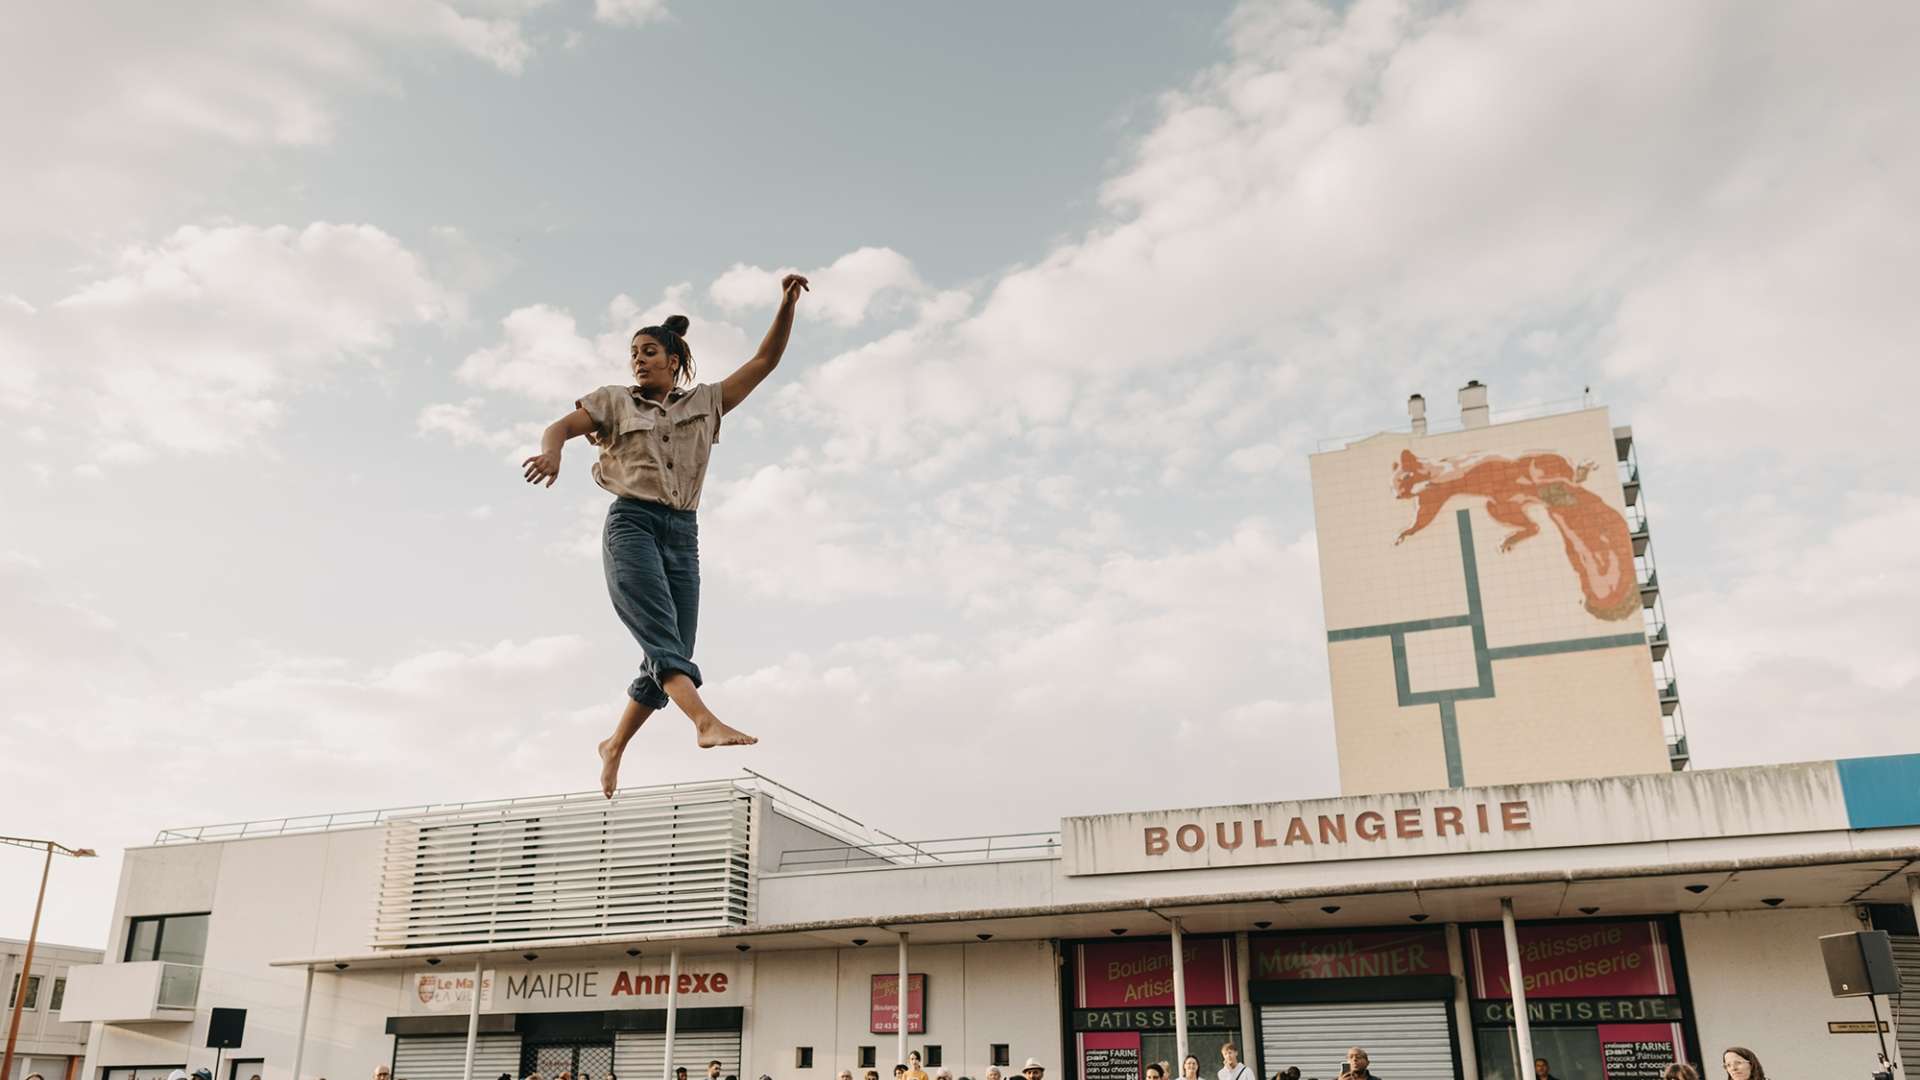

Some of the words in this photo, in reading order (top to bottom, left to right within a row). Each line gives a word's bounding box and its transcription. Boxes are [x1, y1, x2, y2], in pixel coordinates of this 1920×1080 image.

[1144, 800, 1532, 856] BOULANGERIE
[1499, 952, 1641, 994] Vennoiserie
[437, 979, 453, 990] Le
[456, 977, 490, 990] Mas
[506, 971, 599, 999] MAIRIE
[611, 970, 729, 996] Annexe
[1087, 1009, 1225, 1028] PATISSERIE
[1110, 1049, 1137, 1057] FARINE
[1605, 1048, 1633, 1056] pain
[1635, 1042, 1672, 1051] FARINE
